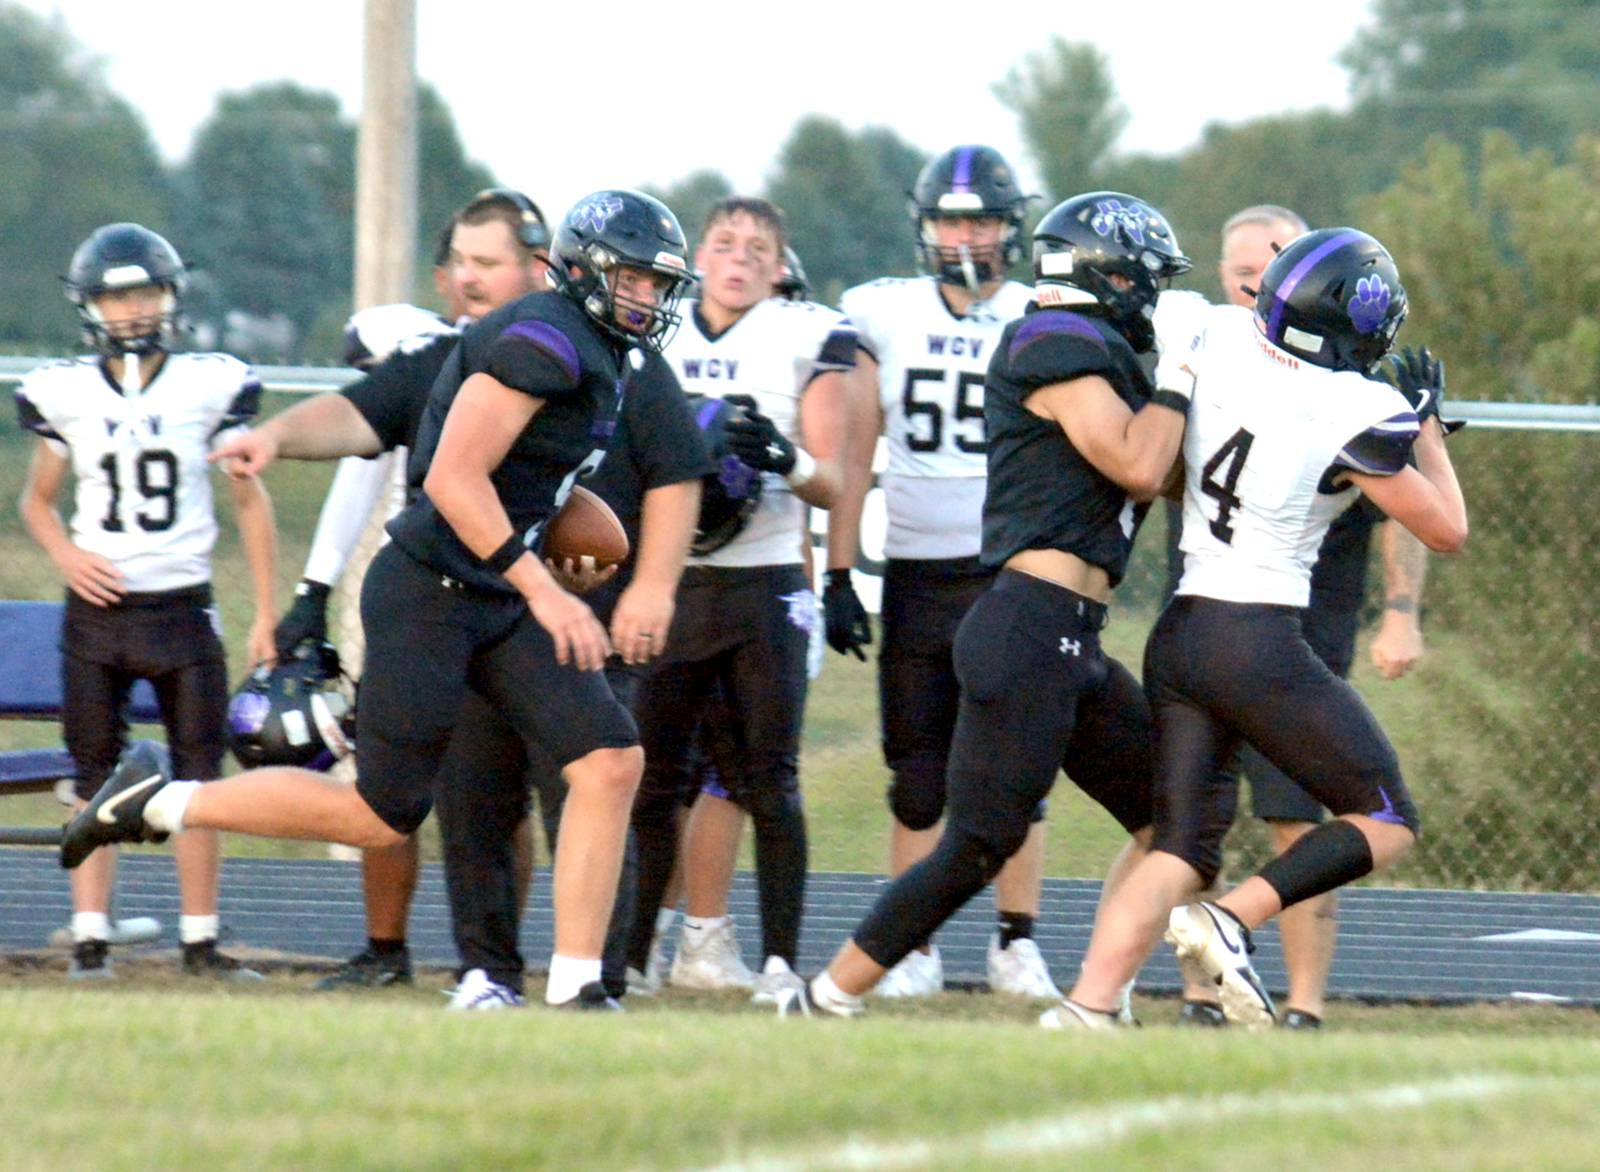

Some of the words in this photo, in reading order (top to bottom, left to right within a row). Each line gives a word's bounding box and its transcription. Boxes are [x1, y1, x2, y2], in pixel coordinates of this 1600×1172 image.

[1036, 288, 1062, 304] ell
[682, 358, 740, 380] WCV
[903, 367, 988, 453] 55
[99, 448, 178, 533] 19
[1201, 426, 1256, 545] 4
